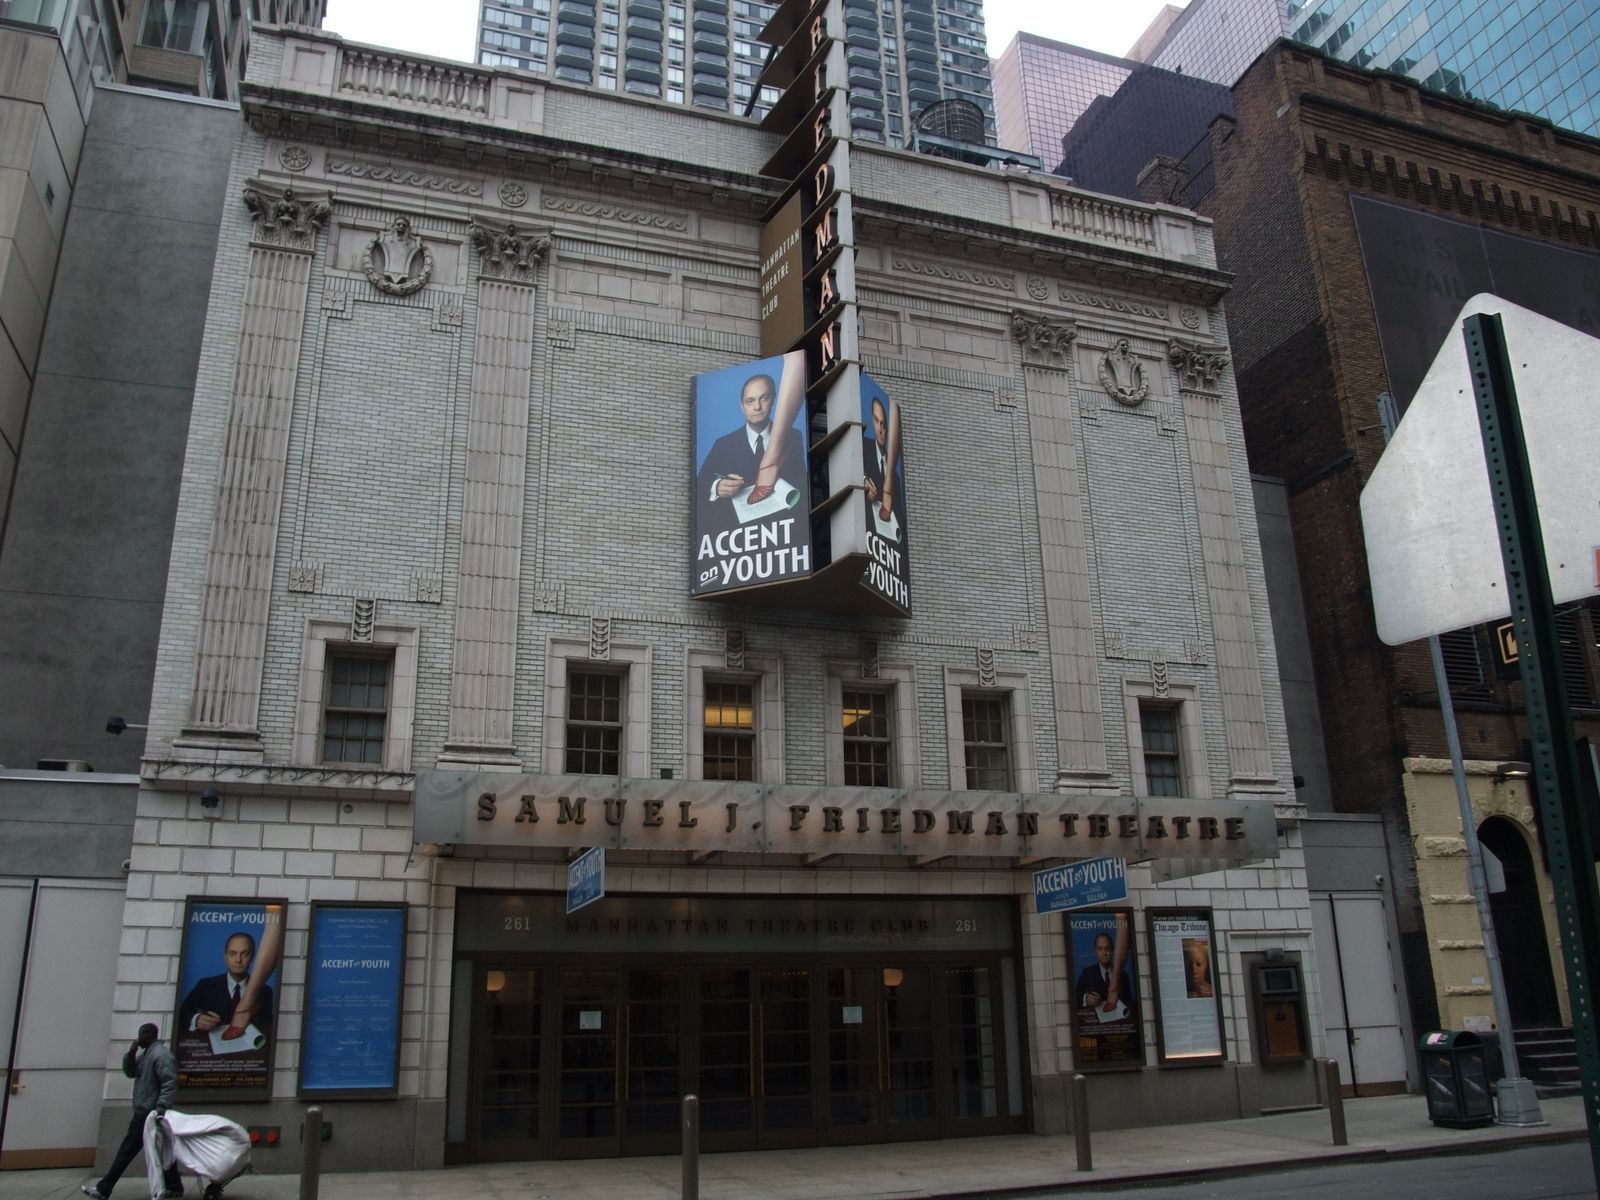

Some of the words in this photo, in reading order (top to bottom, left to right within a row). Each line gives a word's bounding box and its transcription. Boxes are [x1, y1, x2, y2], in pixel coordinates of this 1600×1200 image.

[810, 0, 840, 372] RIEDMAN
[761, 228, 800, 278] MANHATTAN
[762, 261, 790, 298] THEATRE
[762, 294, 779, 320] CLUB
[698, 518, 795, 561] ACCENT
[866, 531, 901, 576] CCENT
[700, 566, 718, 586] on
[720, 545, 810, 585] YOUTH
[869, 561, 909, 608] YOUTH
[477, 792, 698, 828] SAMUEL
[725, 802, 762, 832] J.
[788, 805, 1039, 837] FRIEDMAN
[1059, 813, 1246, 841] THEATRE
[1036, 868, 1074, 895] ACCENT
[1074, 869, 1084, 884] on
[1082, 857, 1123, 885] YOUTH
[191, 911, 234, 923] ACCENT
[242, 912, 280, 924] YOUTH
[504, 917, 531, 931] 261
[565, 918, 729, 933] MANHATTAN
[744, 919, 856, 933] THEATRE
[869, 919, 929, 932] CLUB
[955, 919, 977, 932] 261
[1070, 920, 1097, 930] ACCENT
[1102, 920, 1128, 929] YOUTH
[1153, 922, 1179, 933] Chicago
[1180, 922, 1207, 932] Tribune
[321, 959, 354, 969] ACCENT
[361, 959, 390, 969] YOUTH
